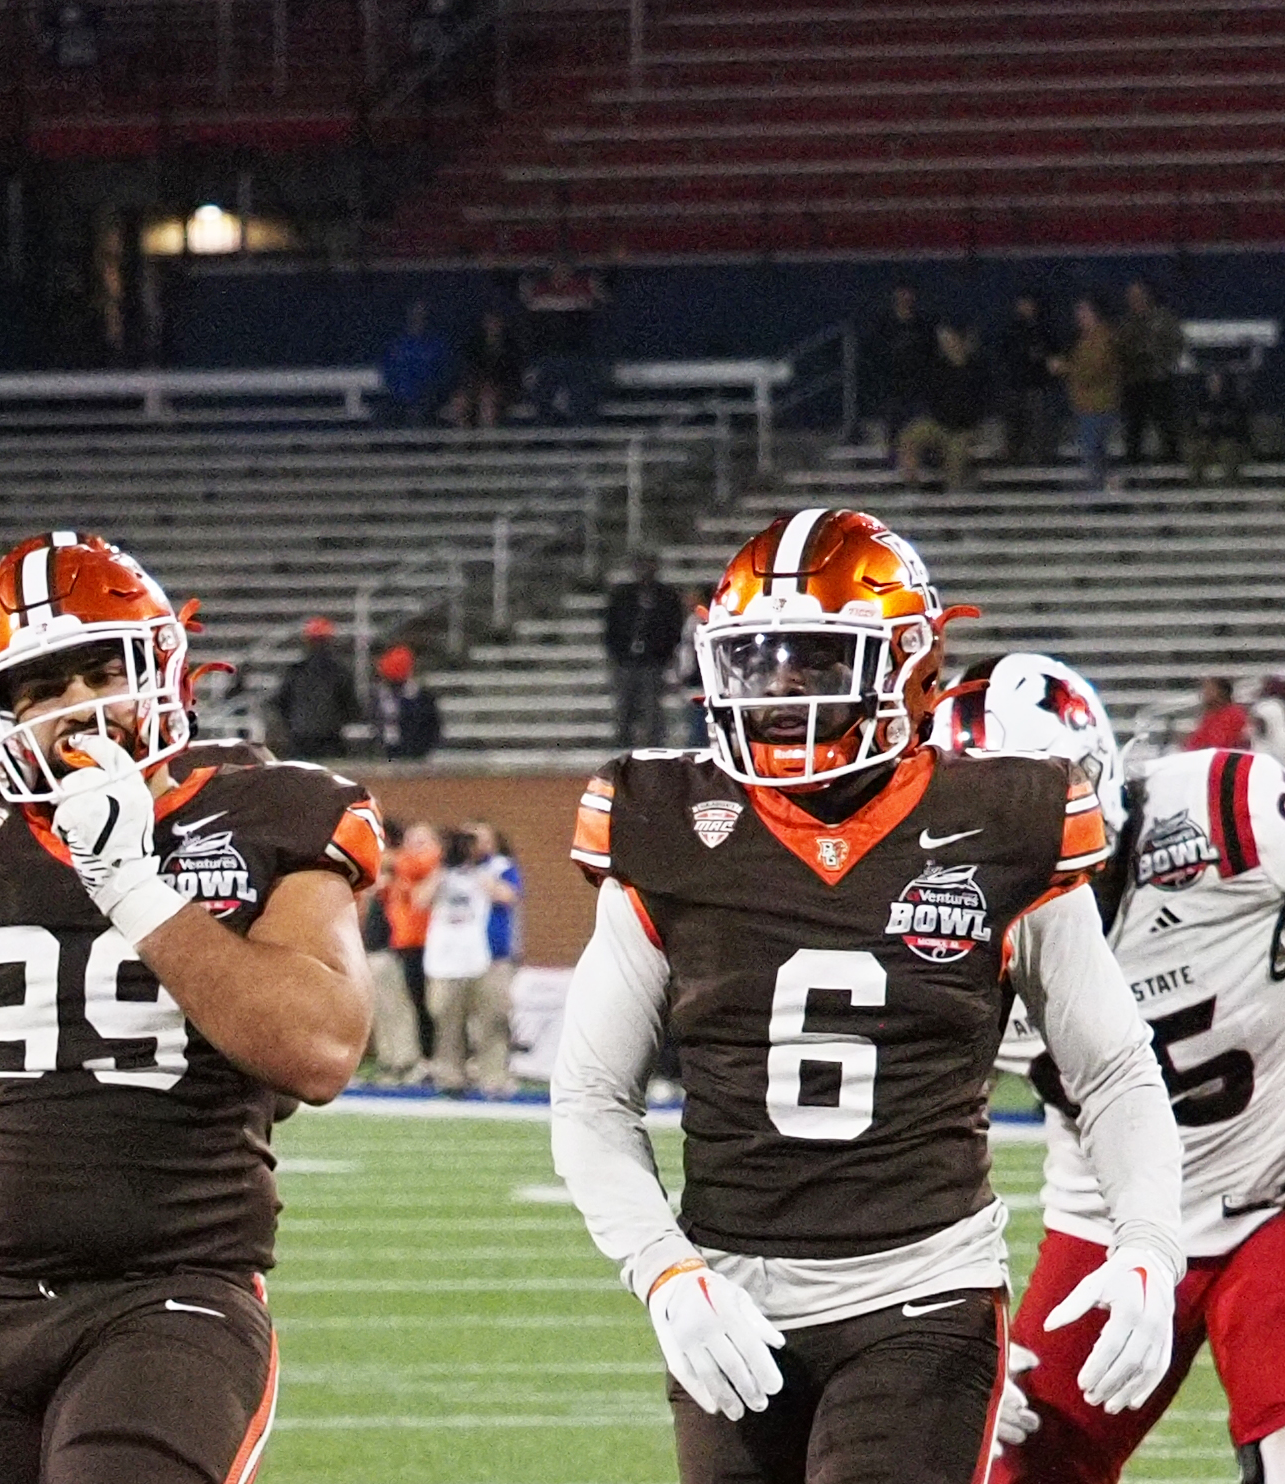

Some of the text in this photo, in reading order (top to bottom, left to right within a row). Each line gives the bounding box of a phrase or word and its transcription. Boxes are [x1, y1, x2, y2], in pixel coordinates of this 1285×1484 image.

[693, 820, 735, 833] MAC
[1139, 836, 1220, 882] BOWL
[918, 889, 979, 907] Ventures
[884, 902, 992, 942] BOWL
[1131, 964, 1194, 1002] STATE
[765, 948, 888, 1140] 6
